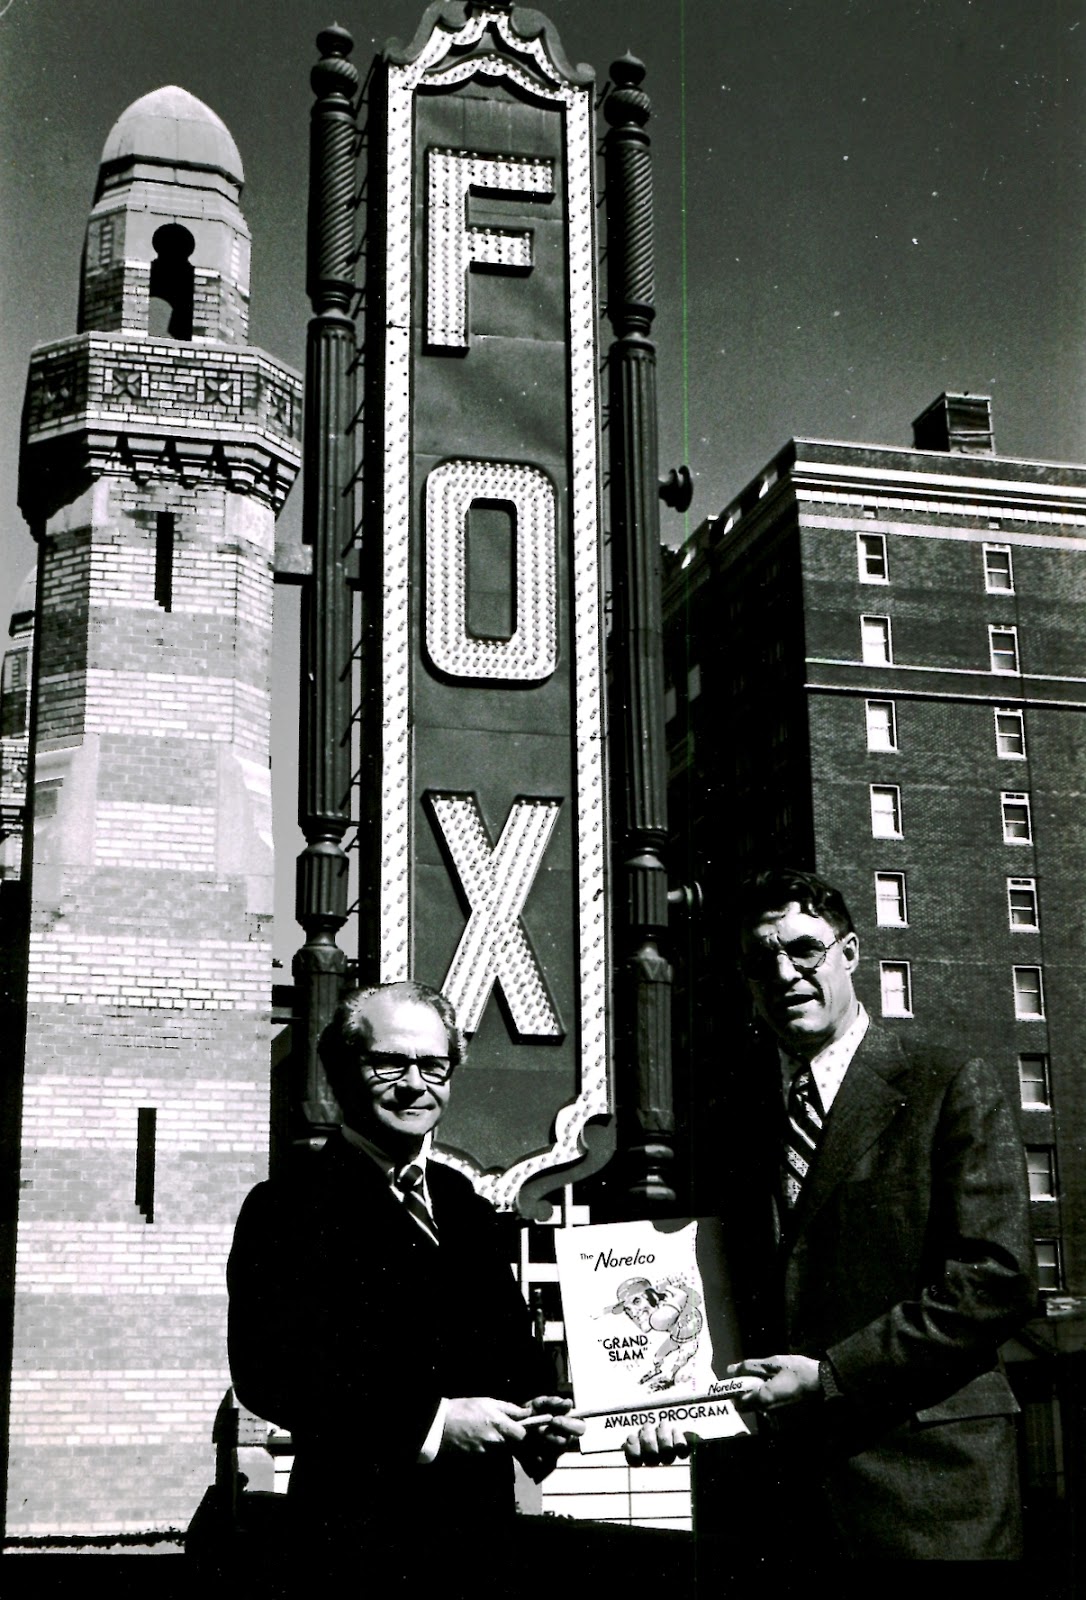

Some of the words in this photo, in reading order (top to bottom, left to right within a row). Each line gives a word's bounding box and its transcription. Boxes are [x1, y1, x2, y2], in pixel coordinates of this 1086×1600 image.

[423, 148, 565, 1044] FOX
[580, 1252, 594, 1260] The
[594, 1248, 655, 1271] Norelco
[708, 1381, 743, 1395] Norelco
[604, 1410, 656, 1429] AWARDS
[659, 1405, 729, 1421] PROGRAM
